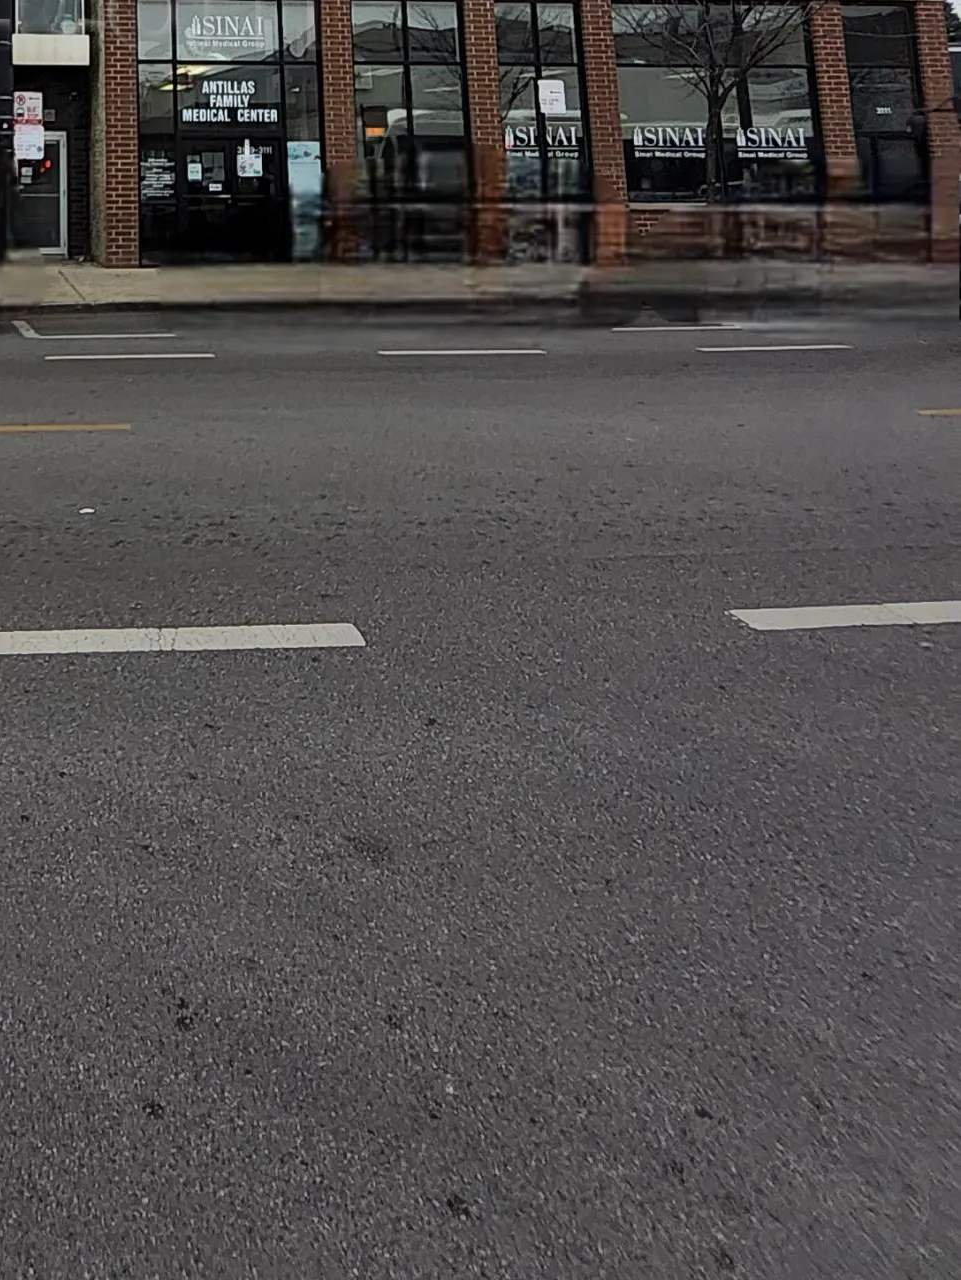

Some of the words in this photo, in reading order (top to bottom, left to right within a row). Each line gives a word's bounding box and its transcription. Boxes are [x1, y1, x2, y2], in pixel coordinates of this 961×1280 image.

[202, 15, 264, 36] SINAI
[212, 40, 241, 48] Medical
[242, 40, 265, 49] Group
[201, 80, 256, 94] ANTILLAS
[209, 94, 250, 108] FAMILY
[181, 108, 231, 122] MEDICAL
[236, 109, 278, 123] CENTER
[515, 125, 579, 146] SINAI
[644, 127, 705, 147] SINAI
[746, 127, 806, 147] SINAI
[634, 150, 653, 158] Sinai
[684, 151, 706, 159] Group
[737, 151, 756, 159] Sinai
[757, 151, 785, 159] Medical
[786, 152, 808, 160] Group
